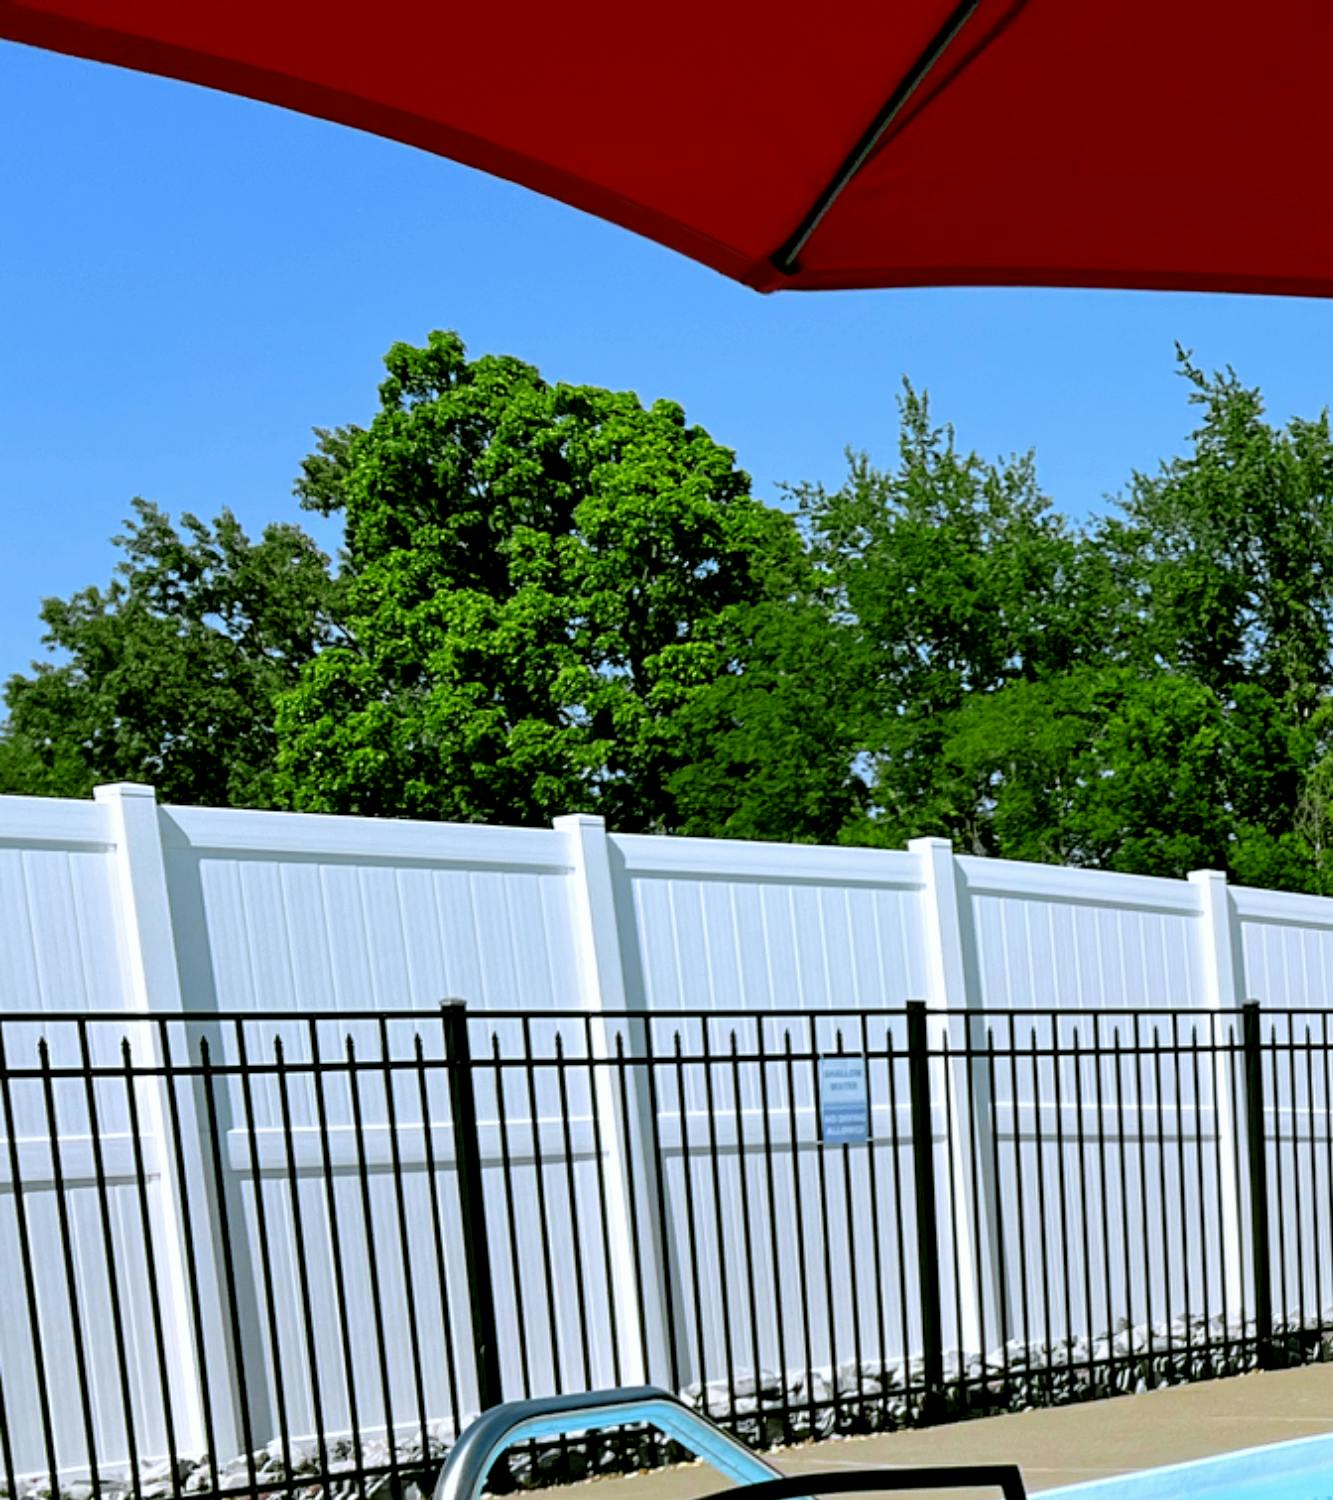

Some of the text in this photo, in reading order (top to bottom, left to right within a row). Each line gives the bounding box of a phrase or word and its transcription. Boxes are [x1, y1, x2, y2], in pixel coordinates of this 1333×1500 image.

[824, 1069, 862, 1078] SHALLOW
[830, 1081, 858, 1091] WATER
[824, 1114, 837, 1123] NO
